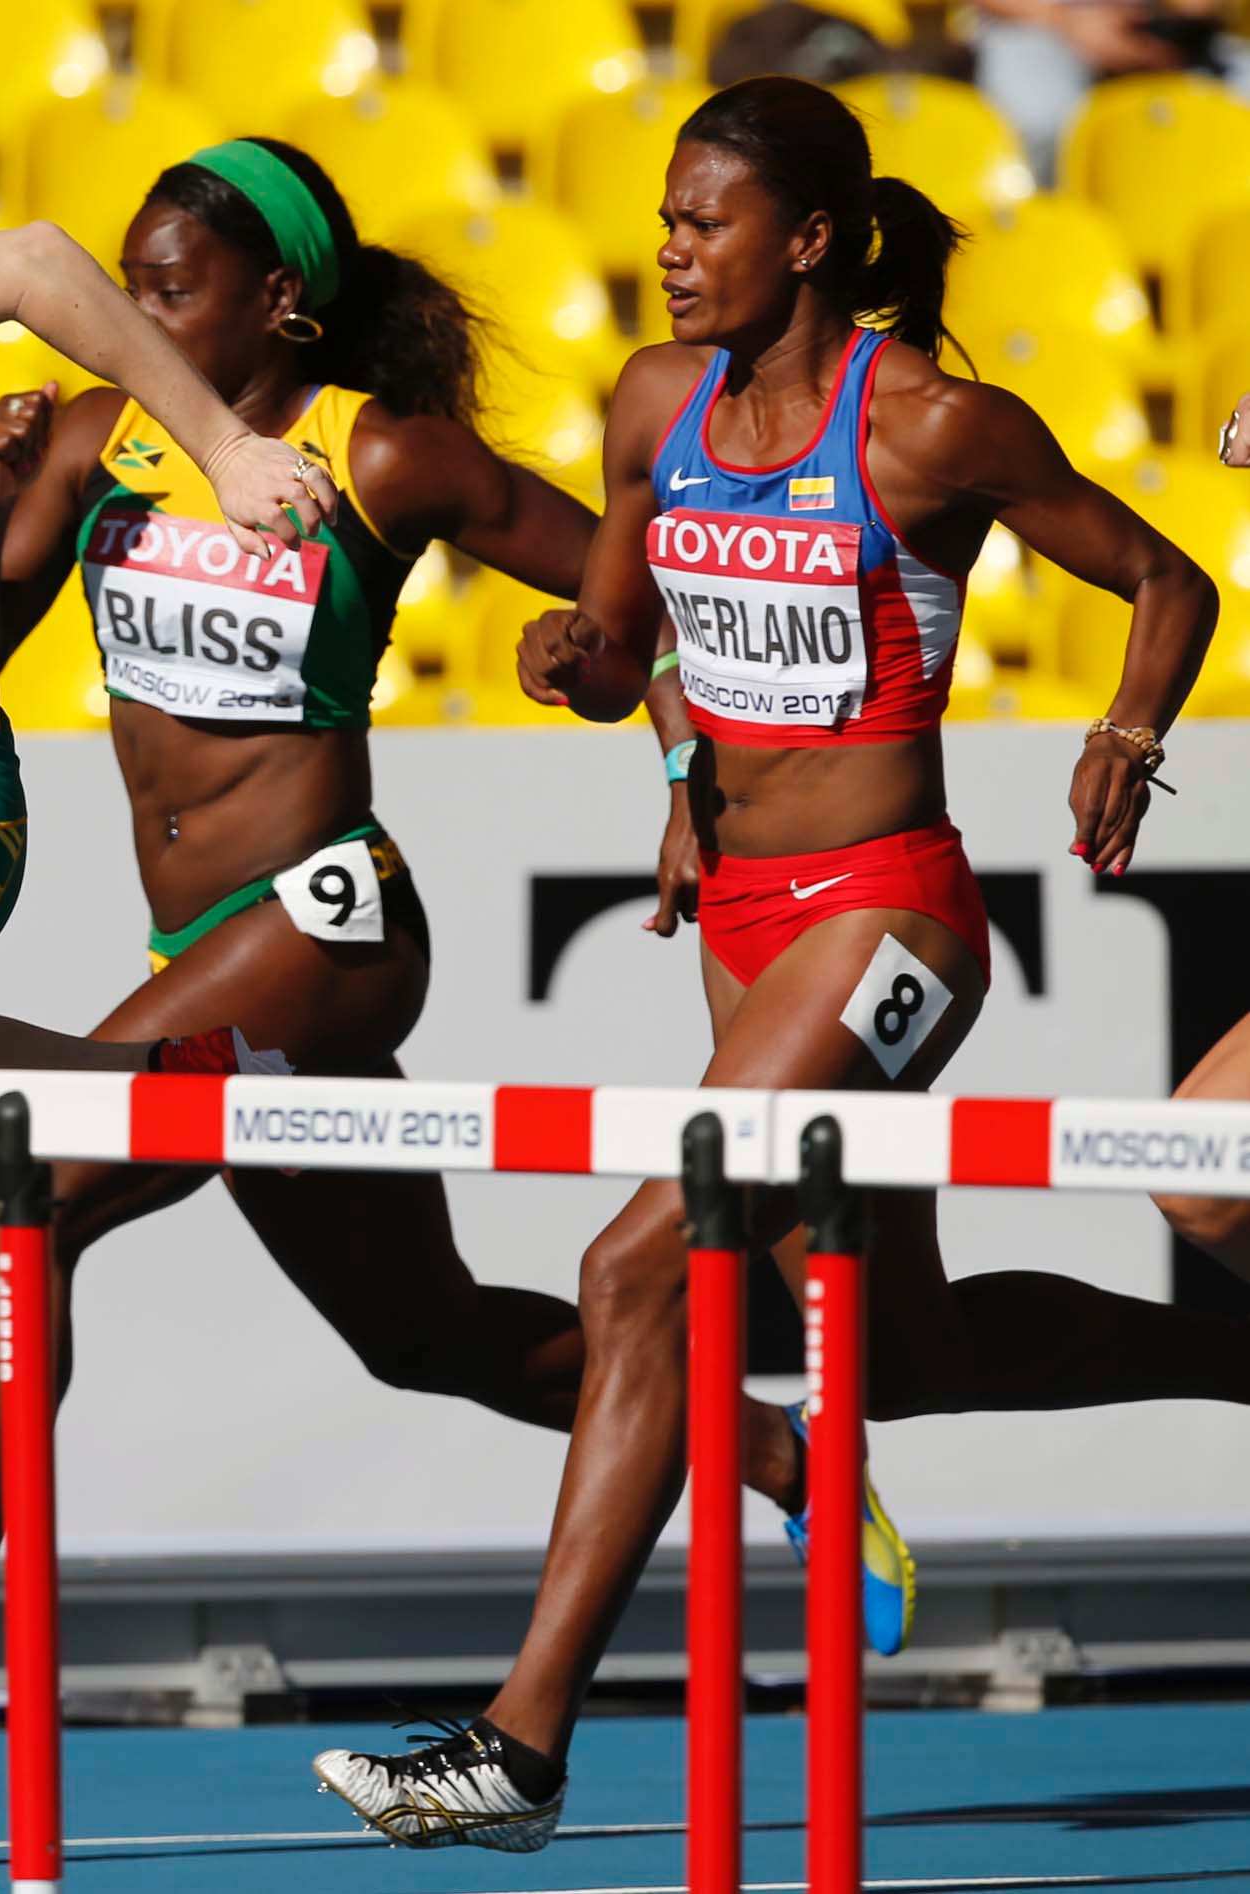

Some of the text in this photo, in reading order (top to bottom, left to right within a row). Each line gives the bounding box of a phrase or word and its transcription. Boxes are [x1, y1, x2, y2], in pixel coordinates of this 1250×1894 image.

[100, 519, 307, 593] TOYOTA
[653, 515, 844, 576] TOYOTA
[104, 588, 284, 672] BLISS
[665, 587, 852, 666] MERLANO
[683, 669, 774, 714] MOSCOW
[308, 864, 357, 928] 9
[873, 972, 926, 1046] 8
[233, 1107, 483, 1148] MOSCOW 2013
[1060, 1129, 1230, 1170] MOSCOW
